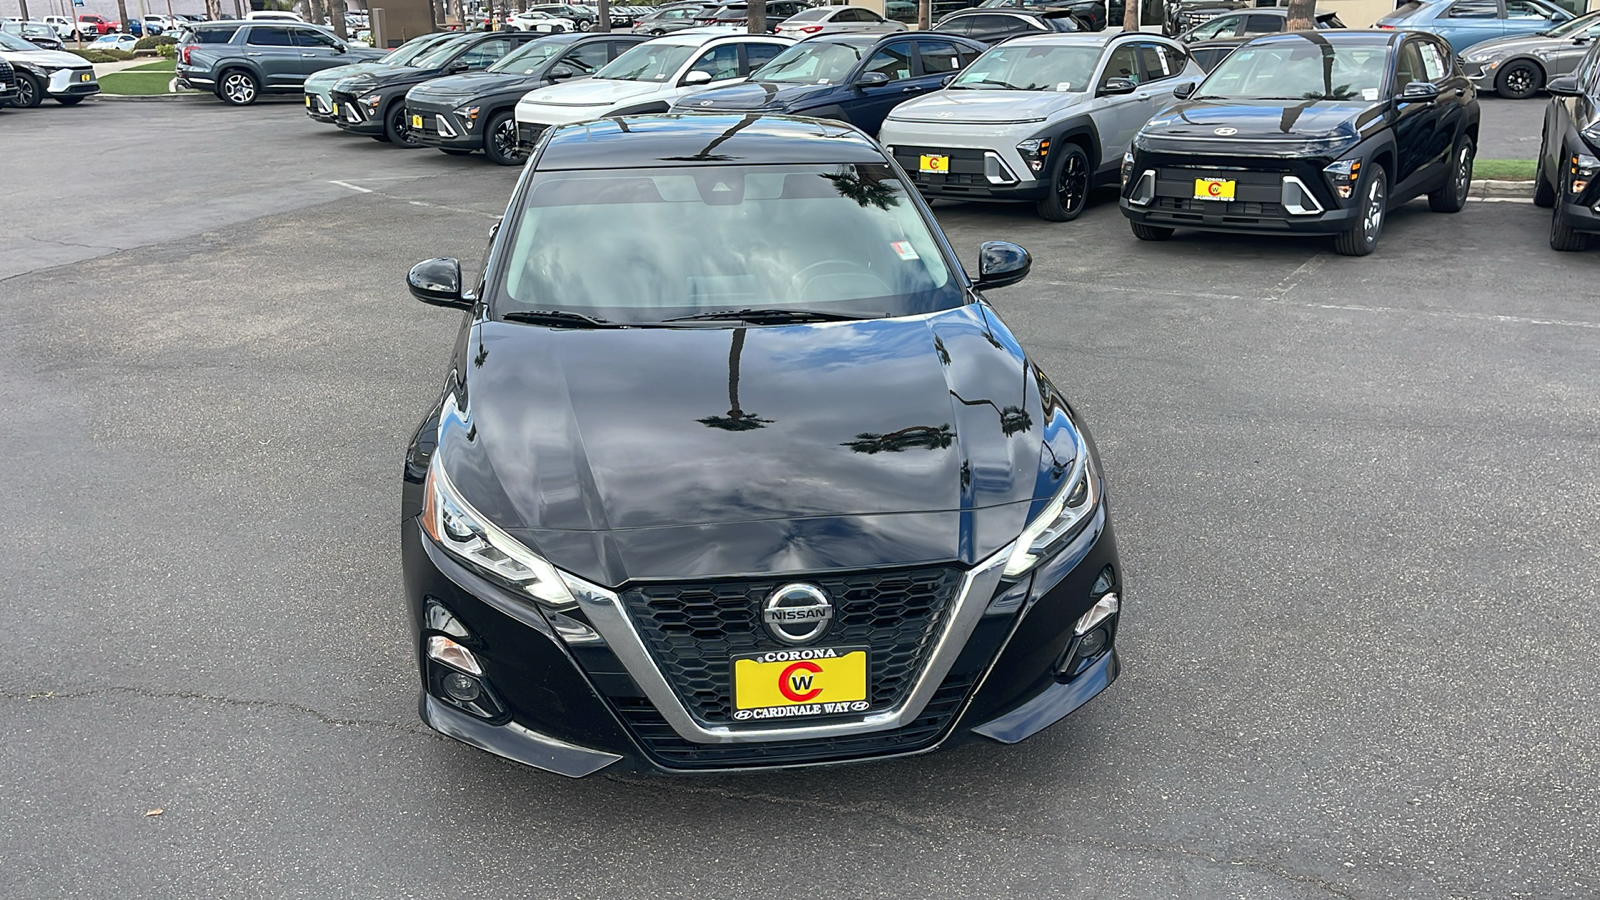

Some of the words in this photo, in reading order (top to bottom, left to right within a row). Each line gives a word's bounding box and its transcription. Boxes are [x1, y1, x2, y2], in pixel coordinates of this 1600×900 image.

[772, 608, 826, 620] NISSAN
[764, 648, 837, 662] CORONA
[753, 703, 821, 719] CARDINALE
[824, 702, 851, 714] WAY
